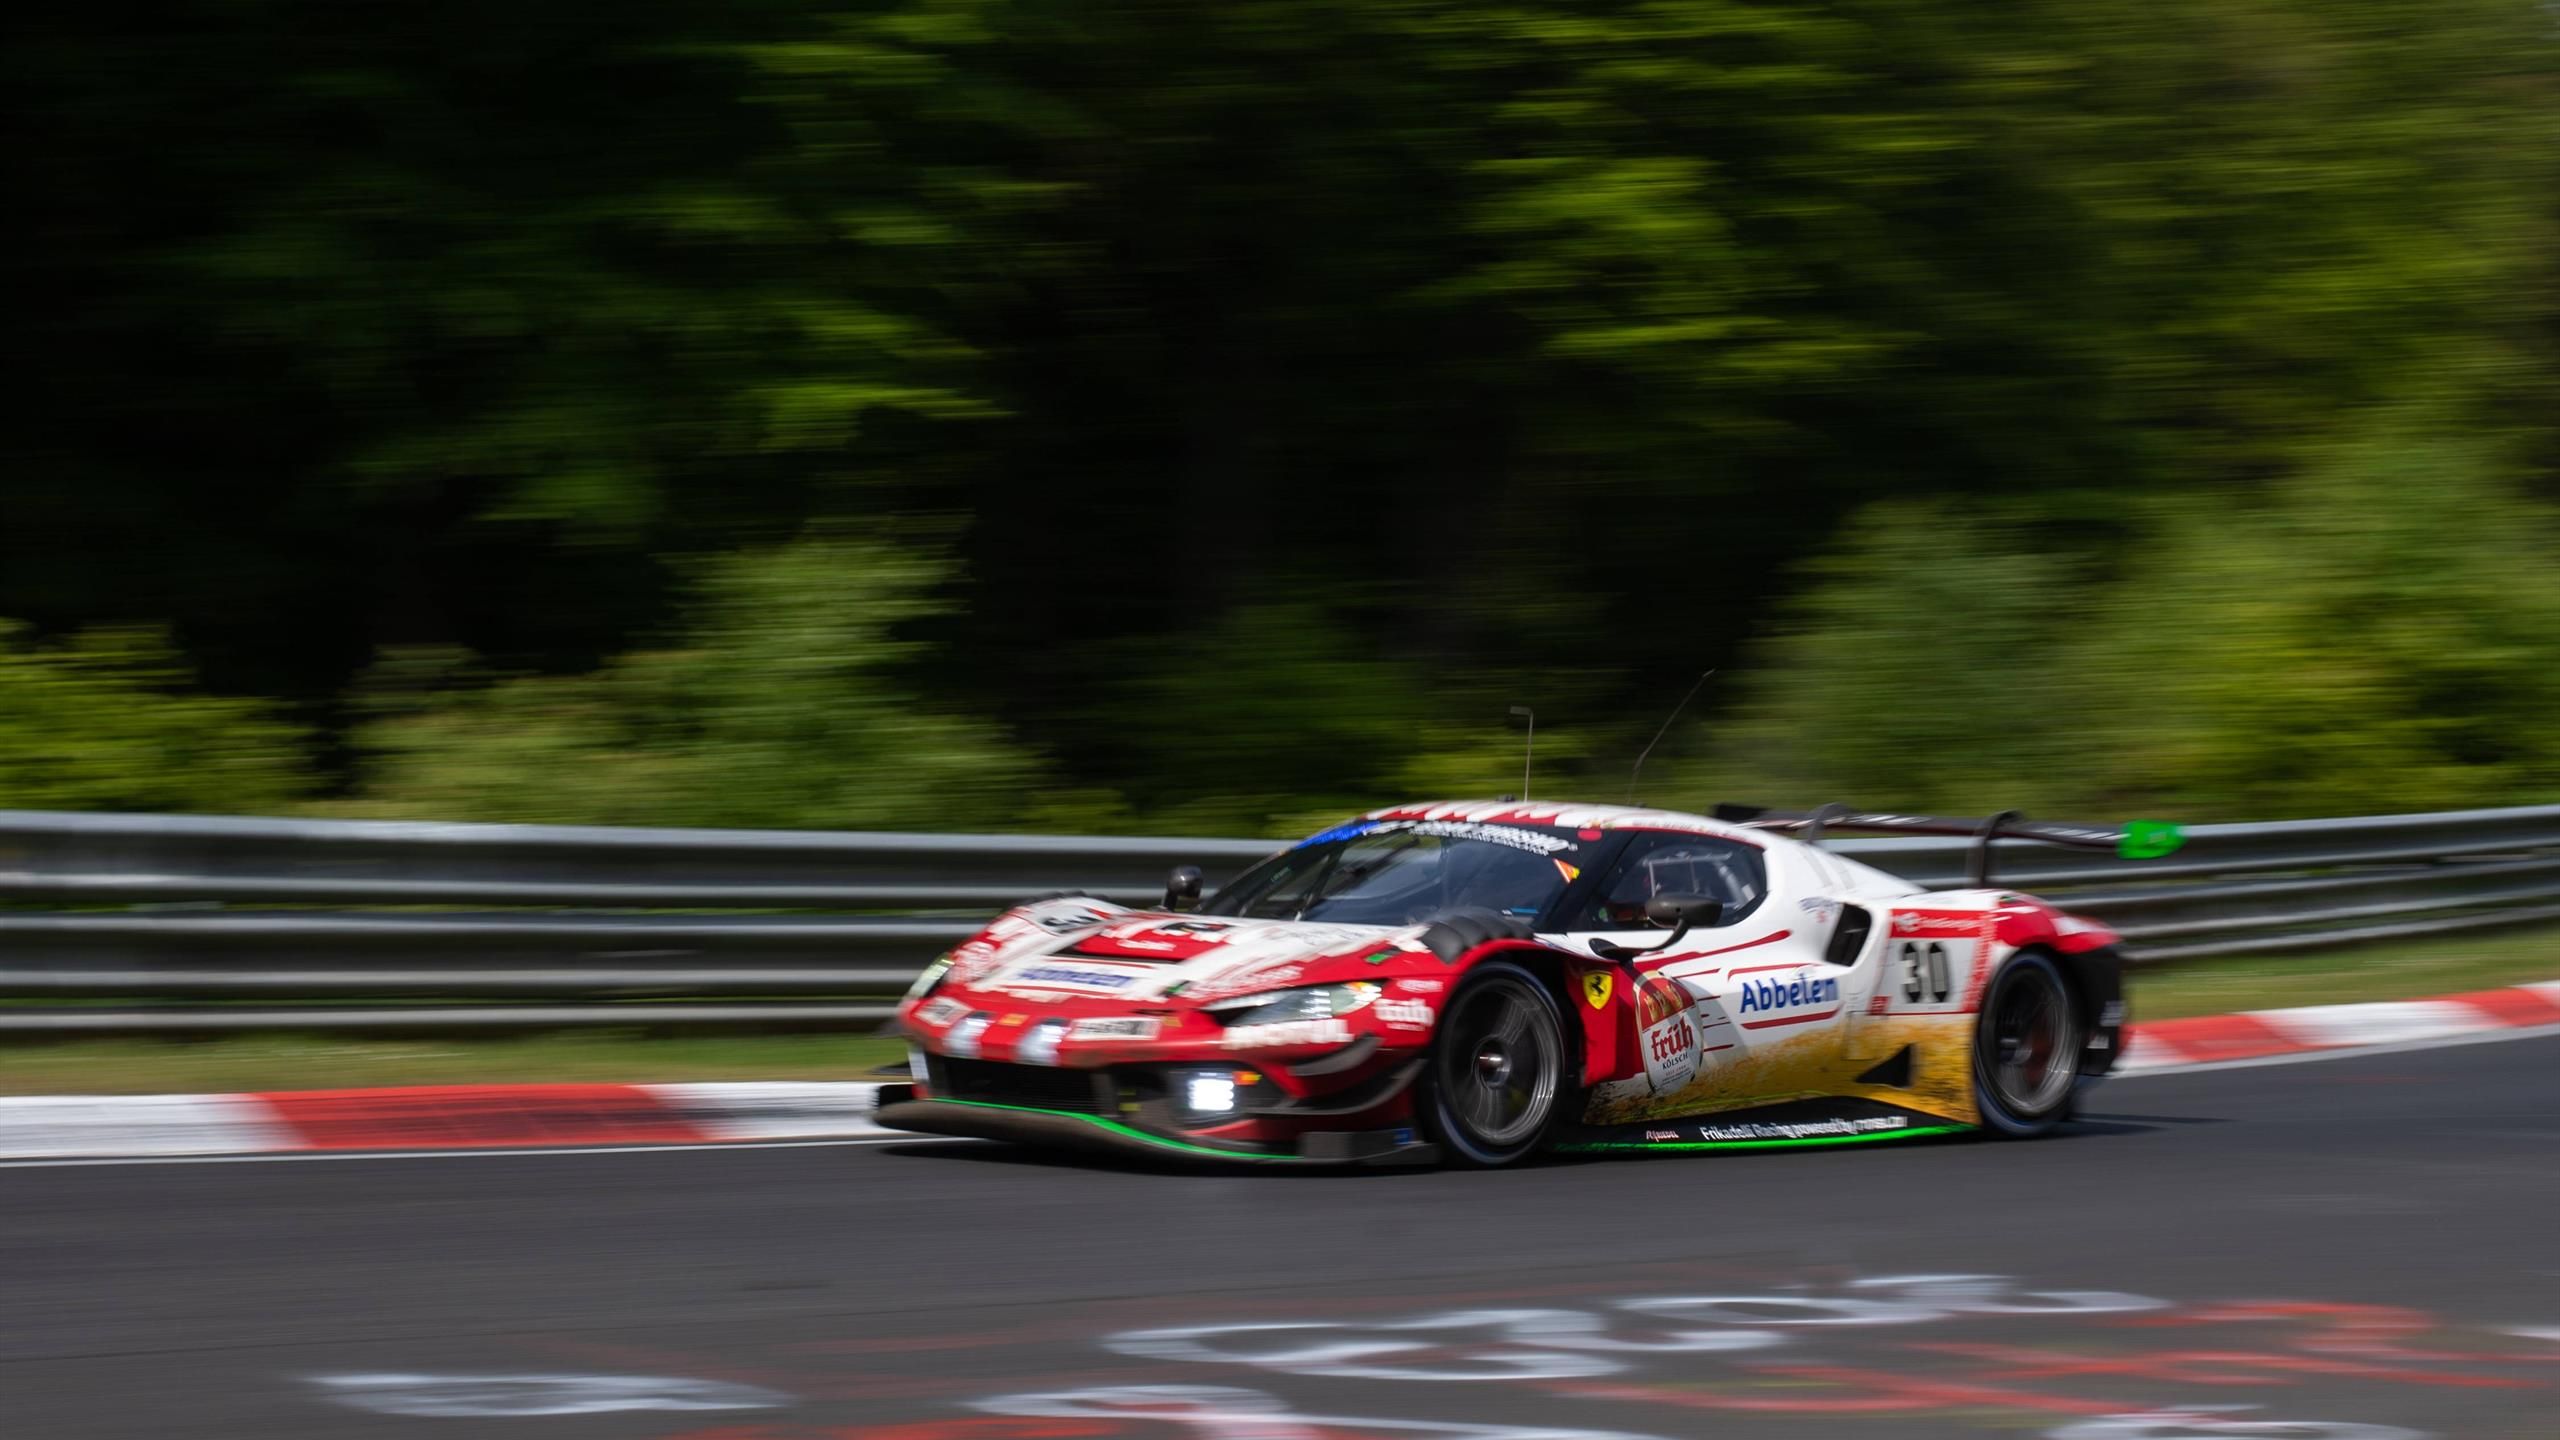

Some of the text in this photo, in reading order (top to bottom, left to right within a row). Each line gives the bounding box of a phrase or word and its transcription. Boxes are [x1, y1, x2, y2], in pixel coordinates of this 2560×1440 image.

[1740, 974, 1839, 1013] Abbelen
[1899, 941, 1950, 1004] 30
[1651, 1016, 1693, 1062] früh
[1662, 1053, 1688, 1070] KÖLSCH
